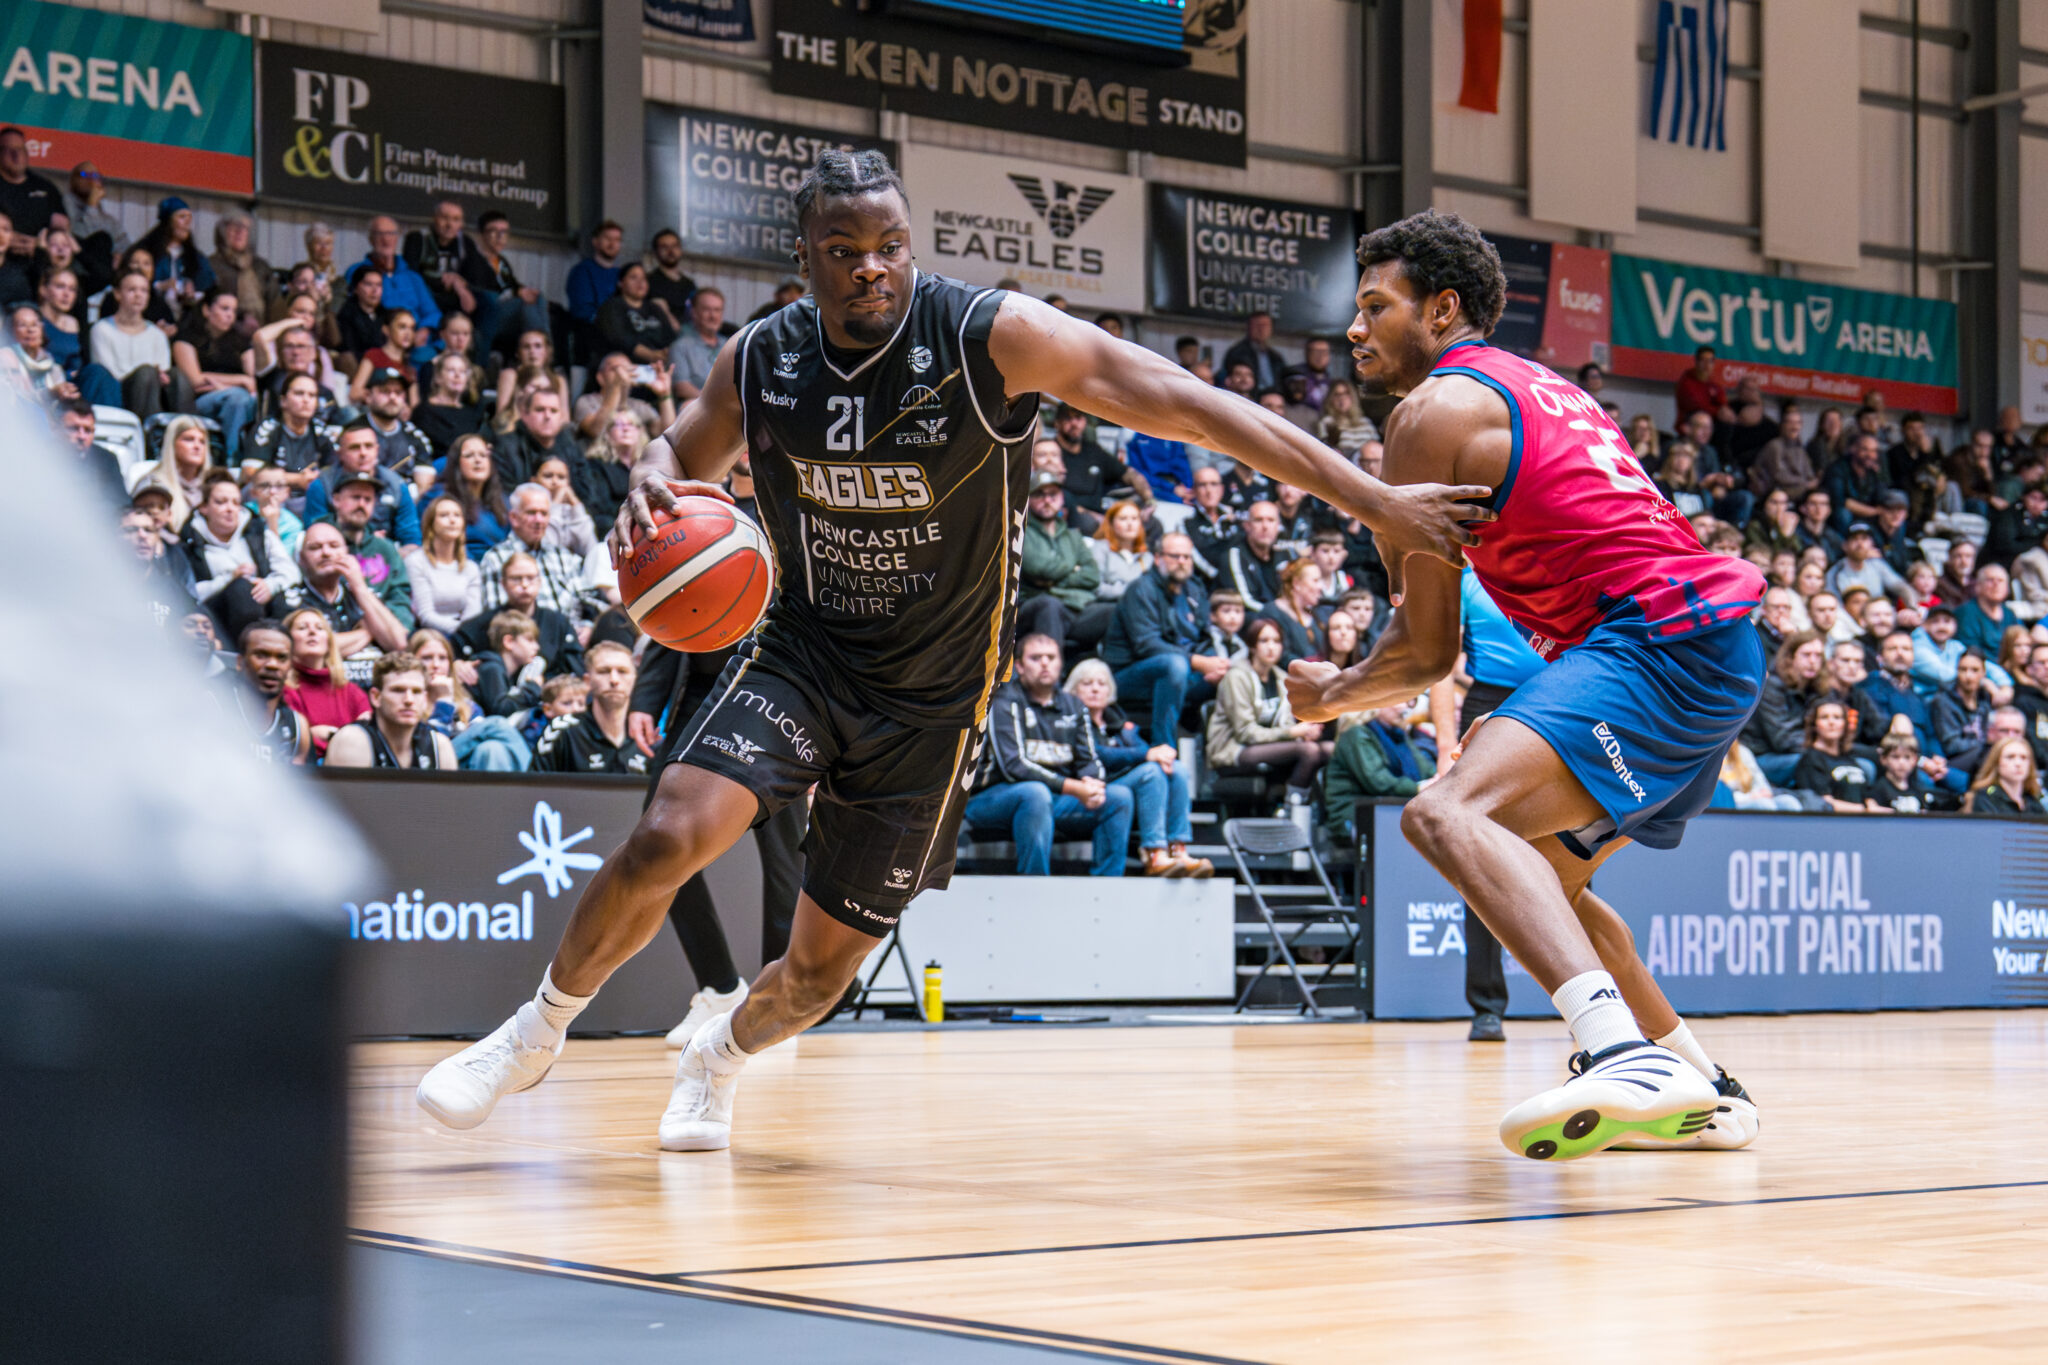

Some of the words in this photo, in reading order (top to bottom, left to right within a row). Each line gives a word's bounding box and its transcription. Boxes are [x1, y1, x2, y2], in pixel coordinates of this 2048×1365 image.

[2, 47, 203, 117] ARENA
[294, 68, 370, 128] FP
[777, 31, 837, 66] THE
[845, 37, 939, 90] KEN
[952, 56, 1148, 126] NOTTAGE
[1159, 98, 1243, 135] STAND
[25, 139, 52, 158] er
[384, 142, 421, 164] Fire
[424, 148, 489, 174] Protect
[491, 160, 526, 180] and
[384, 165, 490, 195] Compliance
[492, 180, 549, 209] Group
[934, 209, 1033, 236] NEWCASTLE
[1197, 199, 1331, 239] NEWCASTLE
[934, 227, 1104, 275] EAGLES
[1197, 229, 1299, 264] COLLEGE
[1199, 259, 1320, 292] UNIVERSITY
[1199, 287, 1282, 318] CENTRE
[1560, 278, 1603, 313] fuse
[1641, 271, 1807, 355] Vertu
[1835, 321, 1936, 363] ARENA
[761, 389, 798, 410] blusky
[826, 396, 865, 451] 21
[896, 433, 948, 445] EAGLES
[792, 460, 932, 509] EAGLES
[812, 515, 942, 548] NEWCASTLE
[631, 529, 686, 577] molten
[812, 540, 909, 571] COLLEGE
[816, 565, 936, 593] UNIVERSITY
[819, 588, 897, 616] CENTRE
[702, 737, 756, 764] EAGLES
[1605, 735, 1646, 803] Dantex
[884, 880, 909, 889] hummel
[1728, 850, 1871, 911] OFFICIAL
[1407, 923, 1468, 957] EA
[1647, 914, 1791, 976] AIRPORT
[1797, 914, 1944, 975] PARTNER
[1992, 946, 2042, 975] Your
